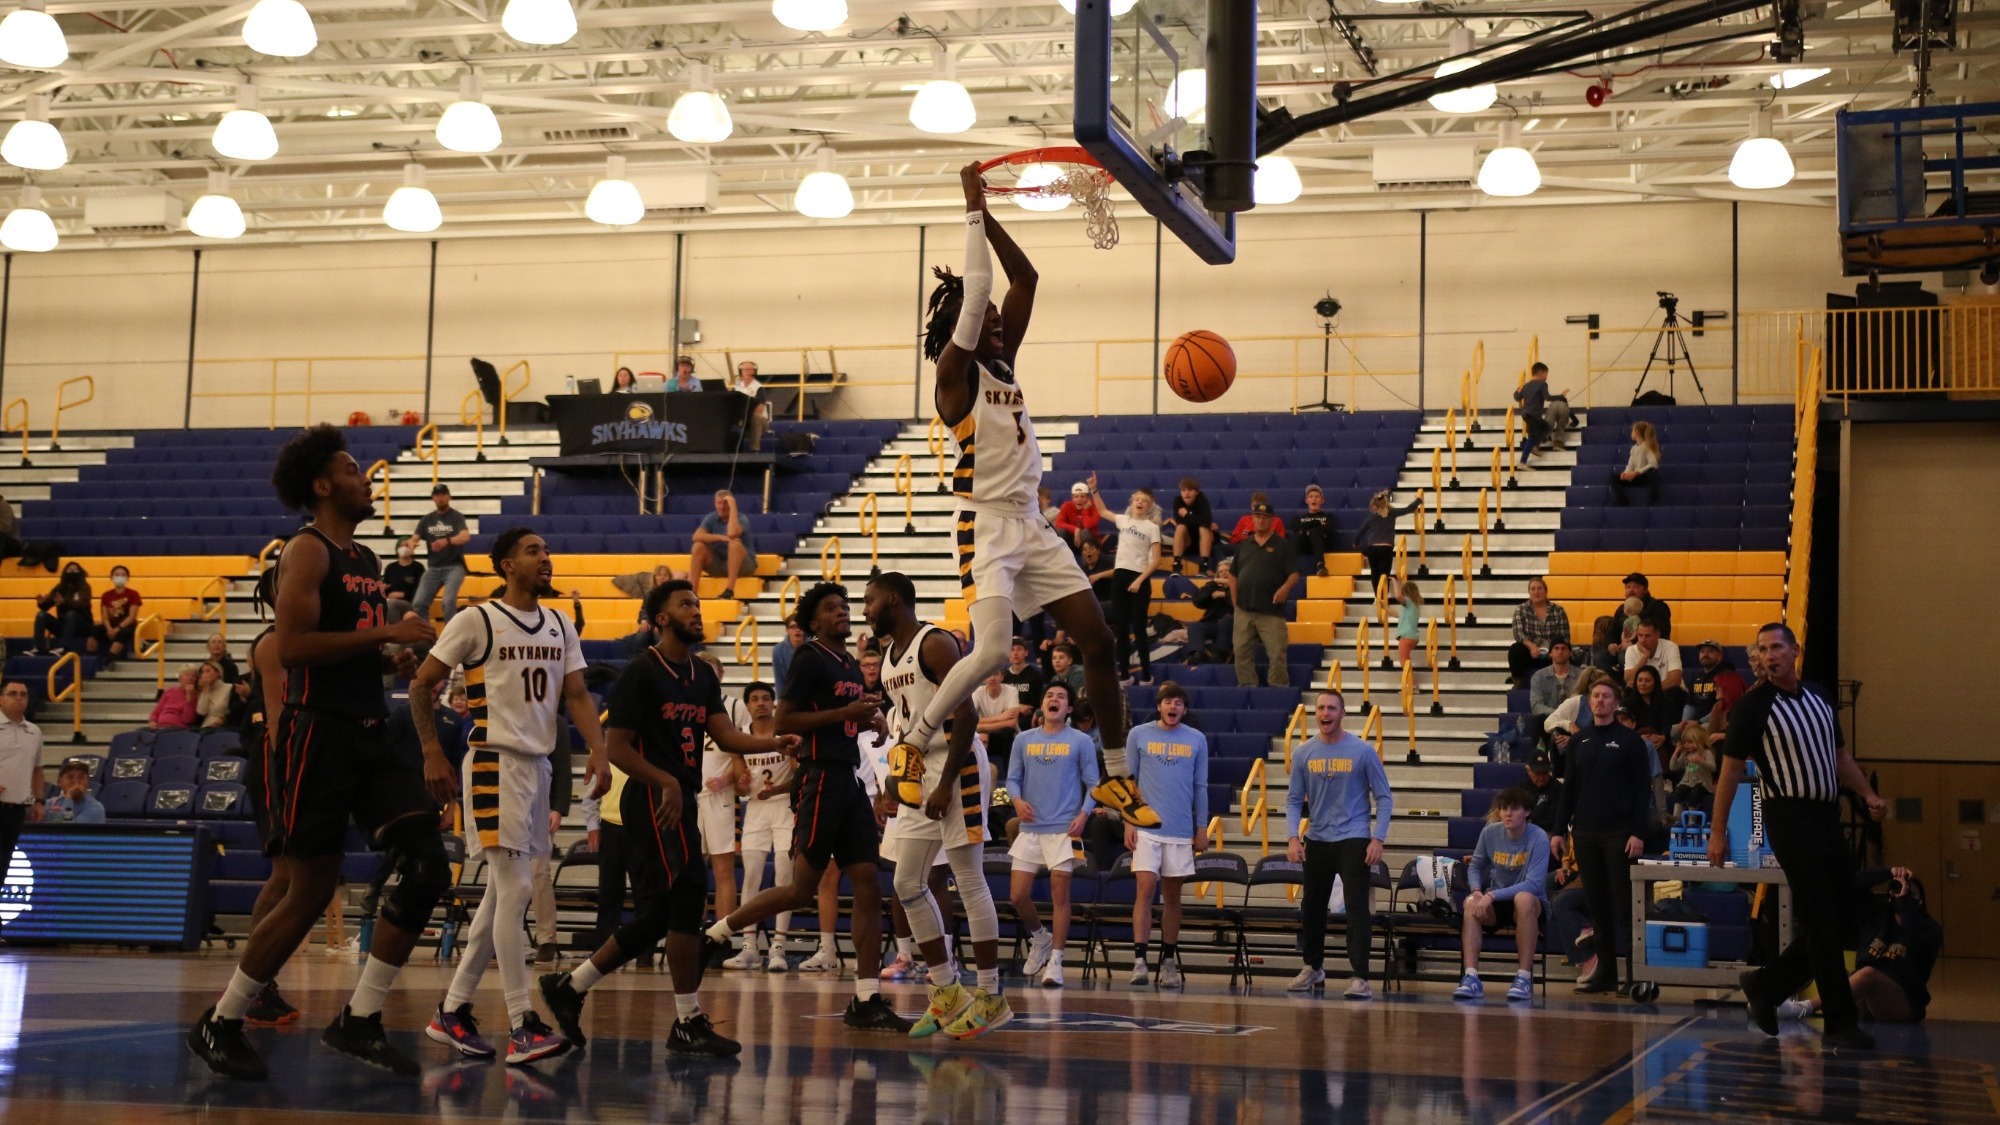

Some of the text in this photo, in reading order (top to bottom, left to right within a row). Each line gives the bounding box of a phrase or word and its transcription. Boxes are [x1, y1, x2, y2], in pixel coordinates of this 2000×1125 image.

[591, 420, 688, 446] SKYHAWKS
[356, 600, 386, 630] 21
[499, 646, 562, 661] SKYHAWKS
[521, 667, 548, 703] 10
[901, 694, 911, 722] 4
[681, 726, 697, 768] 2
[1026, 743, 1071, 756] FORT LEWIS
[1147, 742, 1192, 758] FORT LEWIS
[1307, 757, 1353, 773] FORT LEWIS
[1752, 786, 1763, 845] POWERADE
[1493, 850, 1510, 866] FORT
